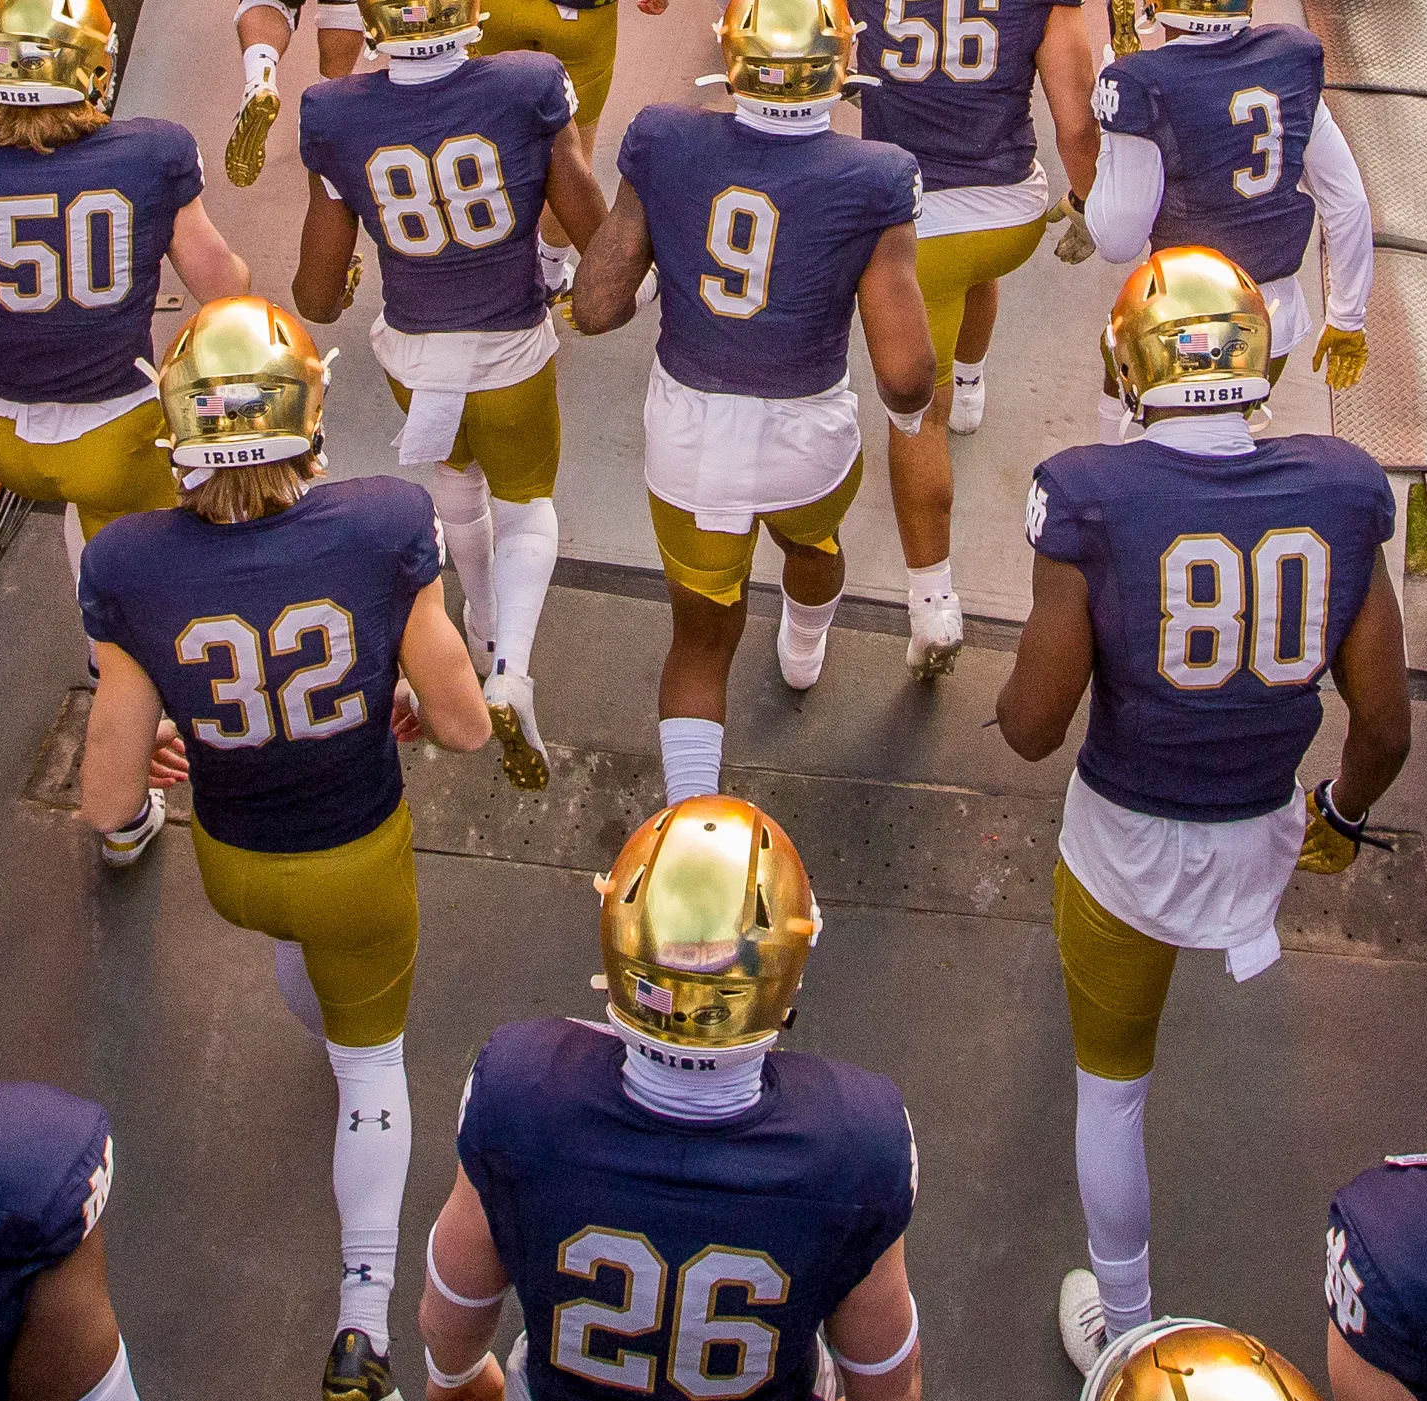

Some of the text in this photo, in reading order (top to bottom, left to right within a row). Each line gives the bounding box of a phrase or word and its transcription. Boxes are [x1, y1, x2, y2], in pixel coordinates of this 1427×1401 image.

[408, 40, 457, 58] IRISH
[1187, 21, 1234, 34] IRISH
[761, 106, 813, 119] IRISH
[1228, 86, 1284, 200] 3
[364, 132, 518, 258] 88
[698, 184, 781, 320] 9
[1183, 386, 1245, 404] IRISH
[203, 447, 267, 466] IRISH
[1156, 525, 1332, 691] 80
[175, 597, 369, 751] 32
[637, 1042, 717, 1072] IRISH
[550, 1224, 791, 1400] 26
